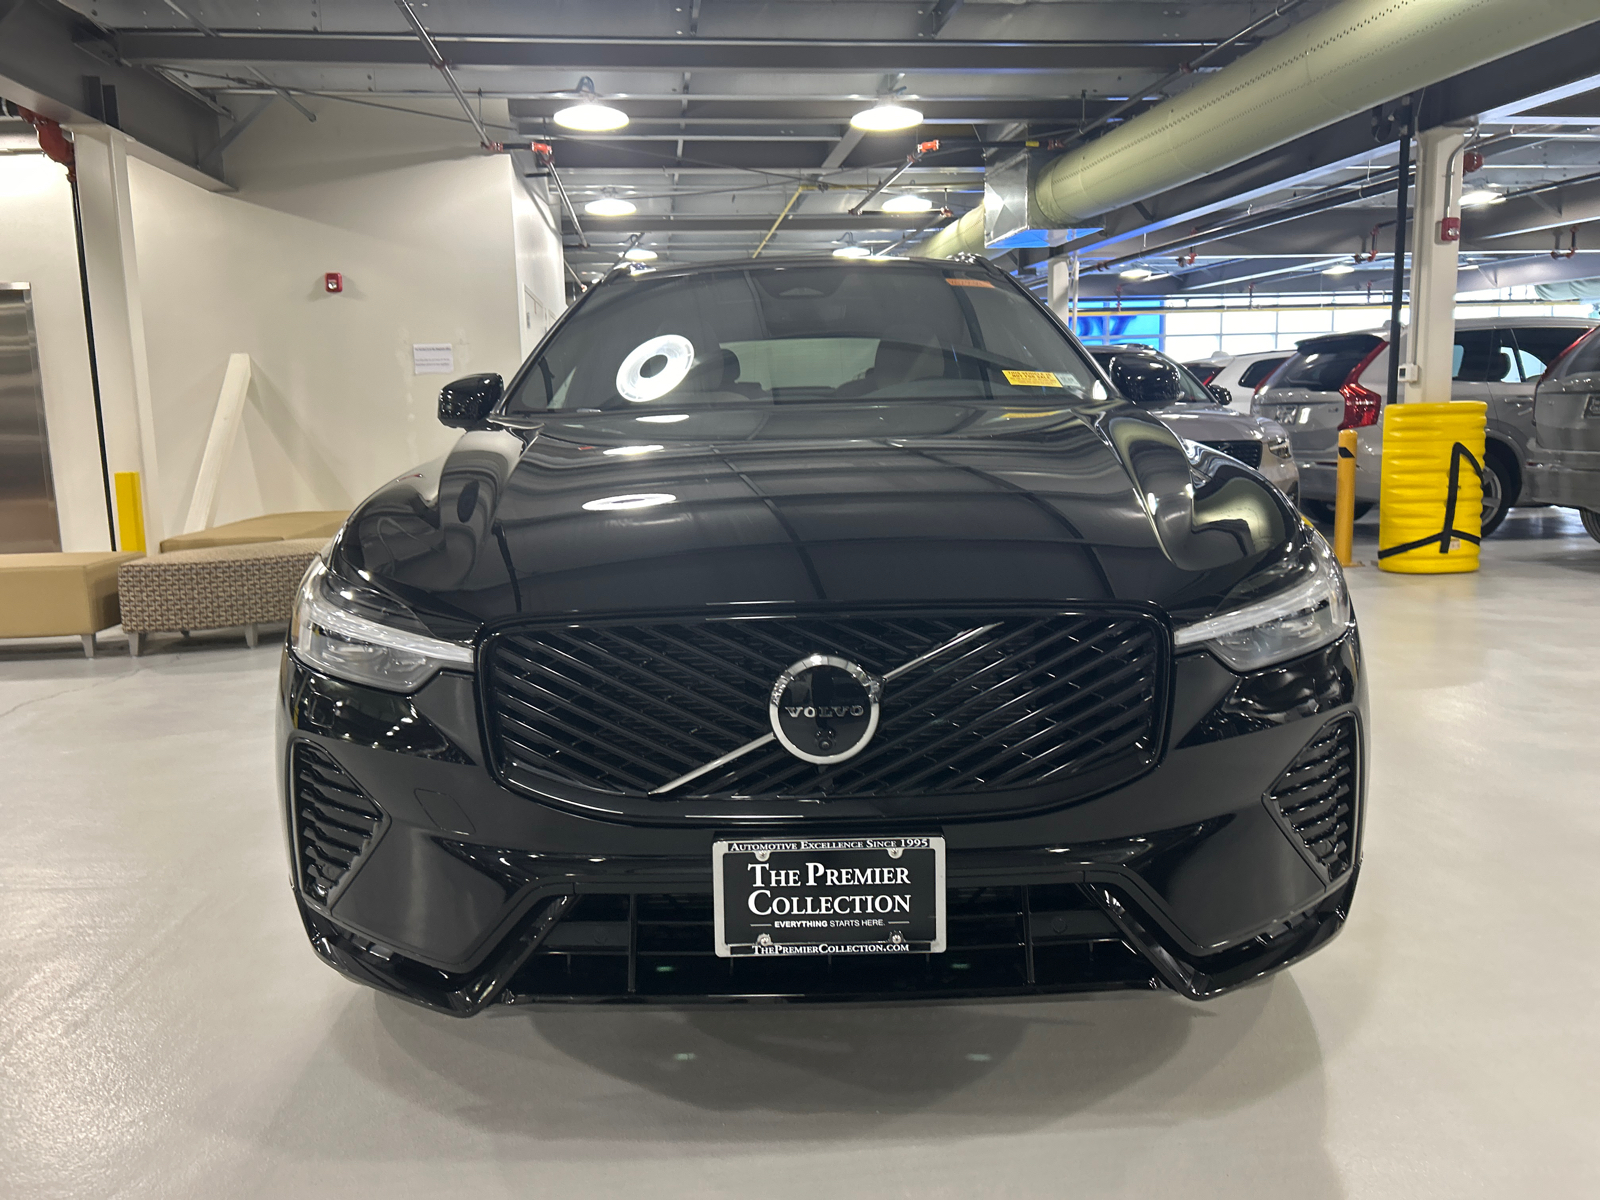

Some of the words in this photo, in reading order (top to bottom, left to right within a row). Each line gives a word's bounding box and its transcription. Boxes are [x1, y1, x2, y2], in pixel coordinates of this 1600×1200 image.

[785, 705, 864, 718] VOLVO
[731, 842, 798, 852] AUTOMOTIVE
[801, 841, 864, 850] EXCELLENCE
[866, 840, 897, 848] SINCE
[900, 839, 928, 848] 1995
[747, 863, 801, 888] THE
[805, 862, 911, 887] PREMIER
[748, 889, 912, 916] COLLECTION
[774, 920, 828, 928] EVERYTHING
[829, 919, 860, 928] STARTS
[861, 919, 886, 927] HERE.
